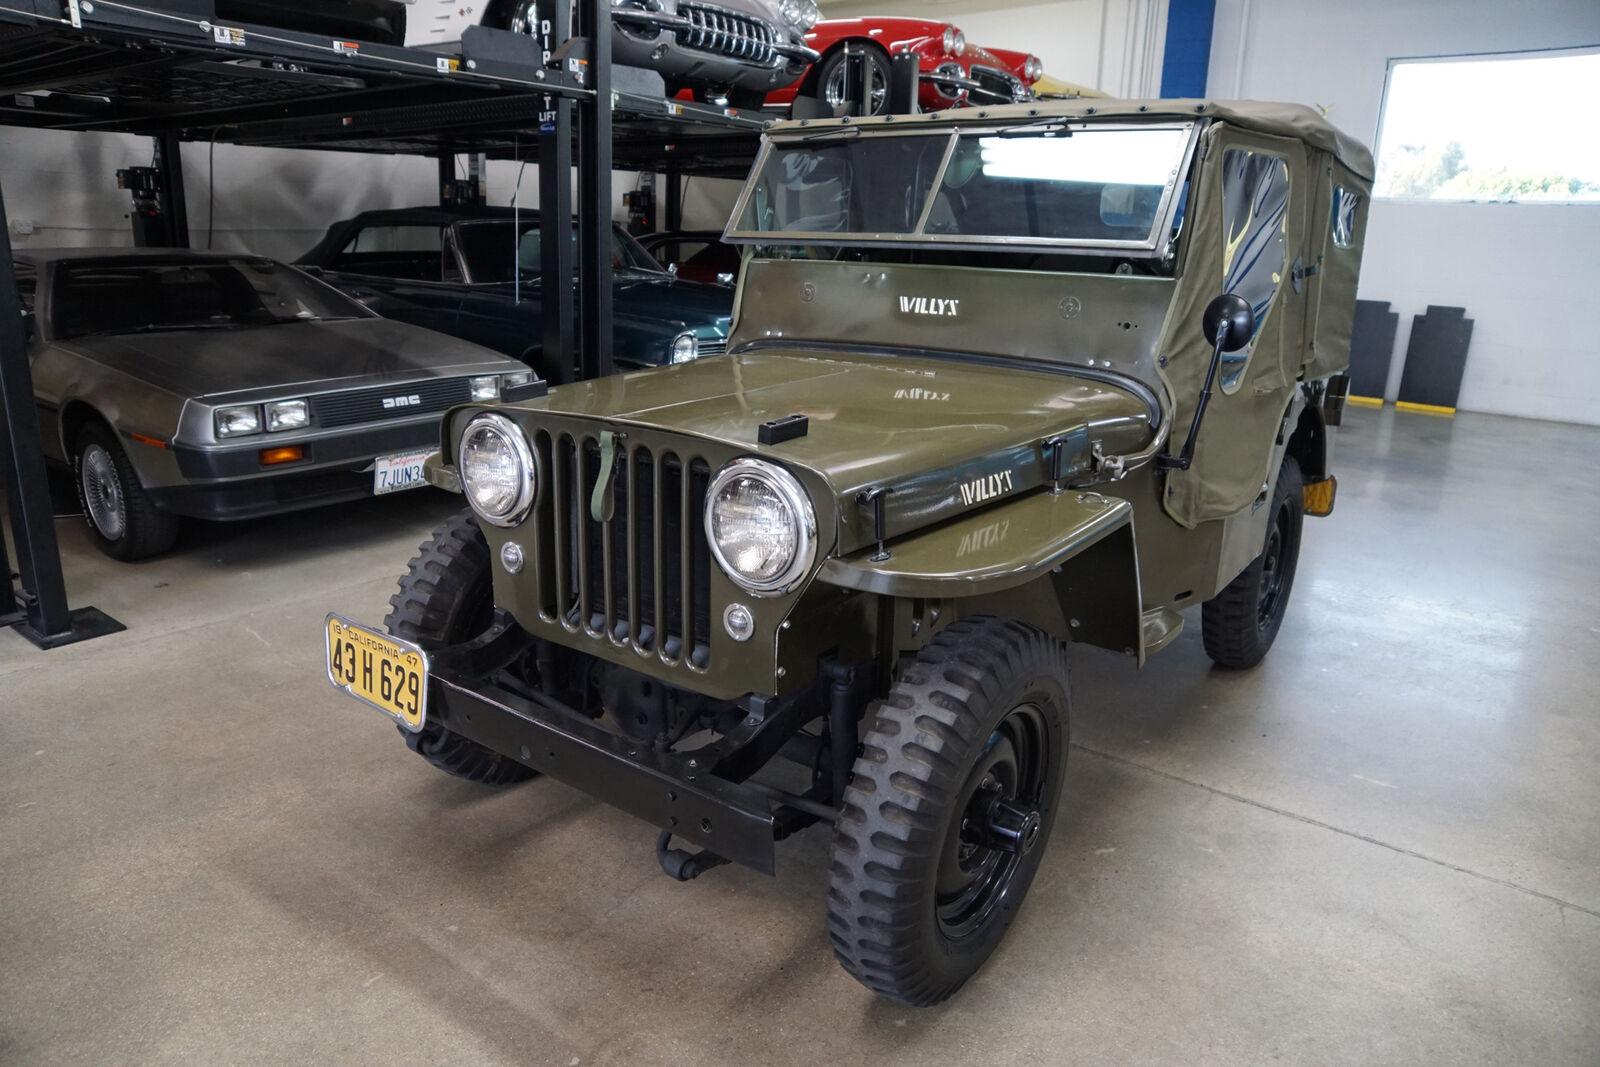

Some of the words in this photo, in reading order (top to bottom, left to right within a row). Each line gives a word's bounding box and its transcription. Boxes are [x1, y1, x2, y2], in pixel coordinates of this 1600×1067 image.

[541, 20, 552, 110] DIRT
[539, 111, 556, 122] LIFT
[899, 295, 959, 316] WILLYS
[960, 469, 1013, 506] WILLYS
[332, 623, 342, 635] 19
[348, 630, 400, 659] CALIFORNIA
[406, 654, 418, 667] 47
[333, 638, 356, 684] 43
[362, 649, 373, 694] H
[380, 658, 420, 716] 629
